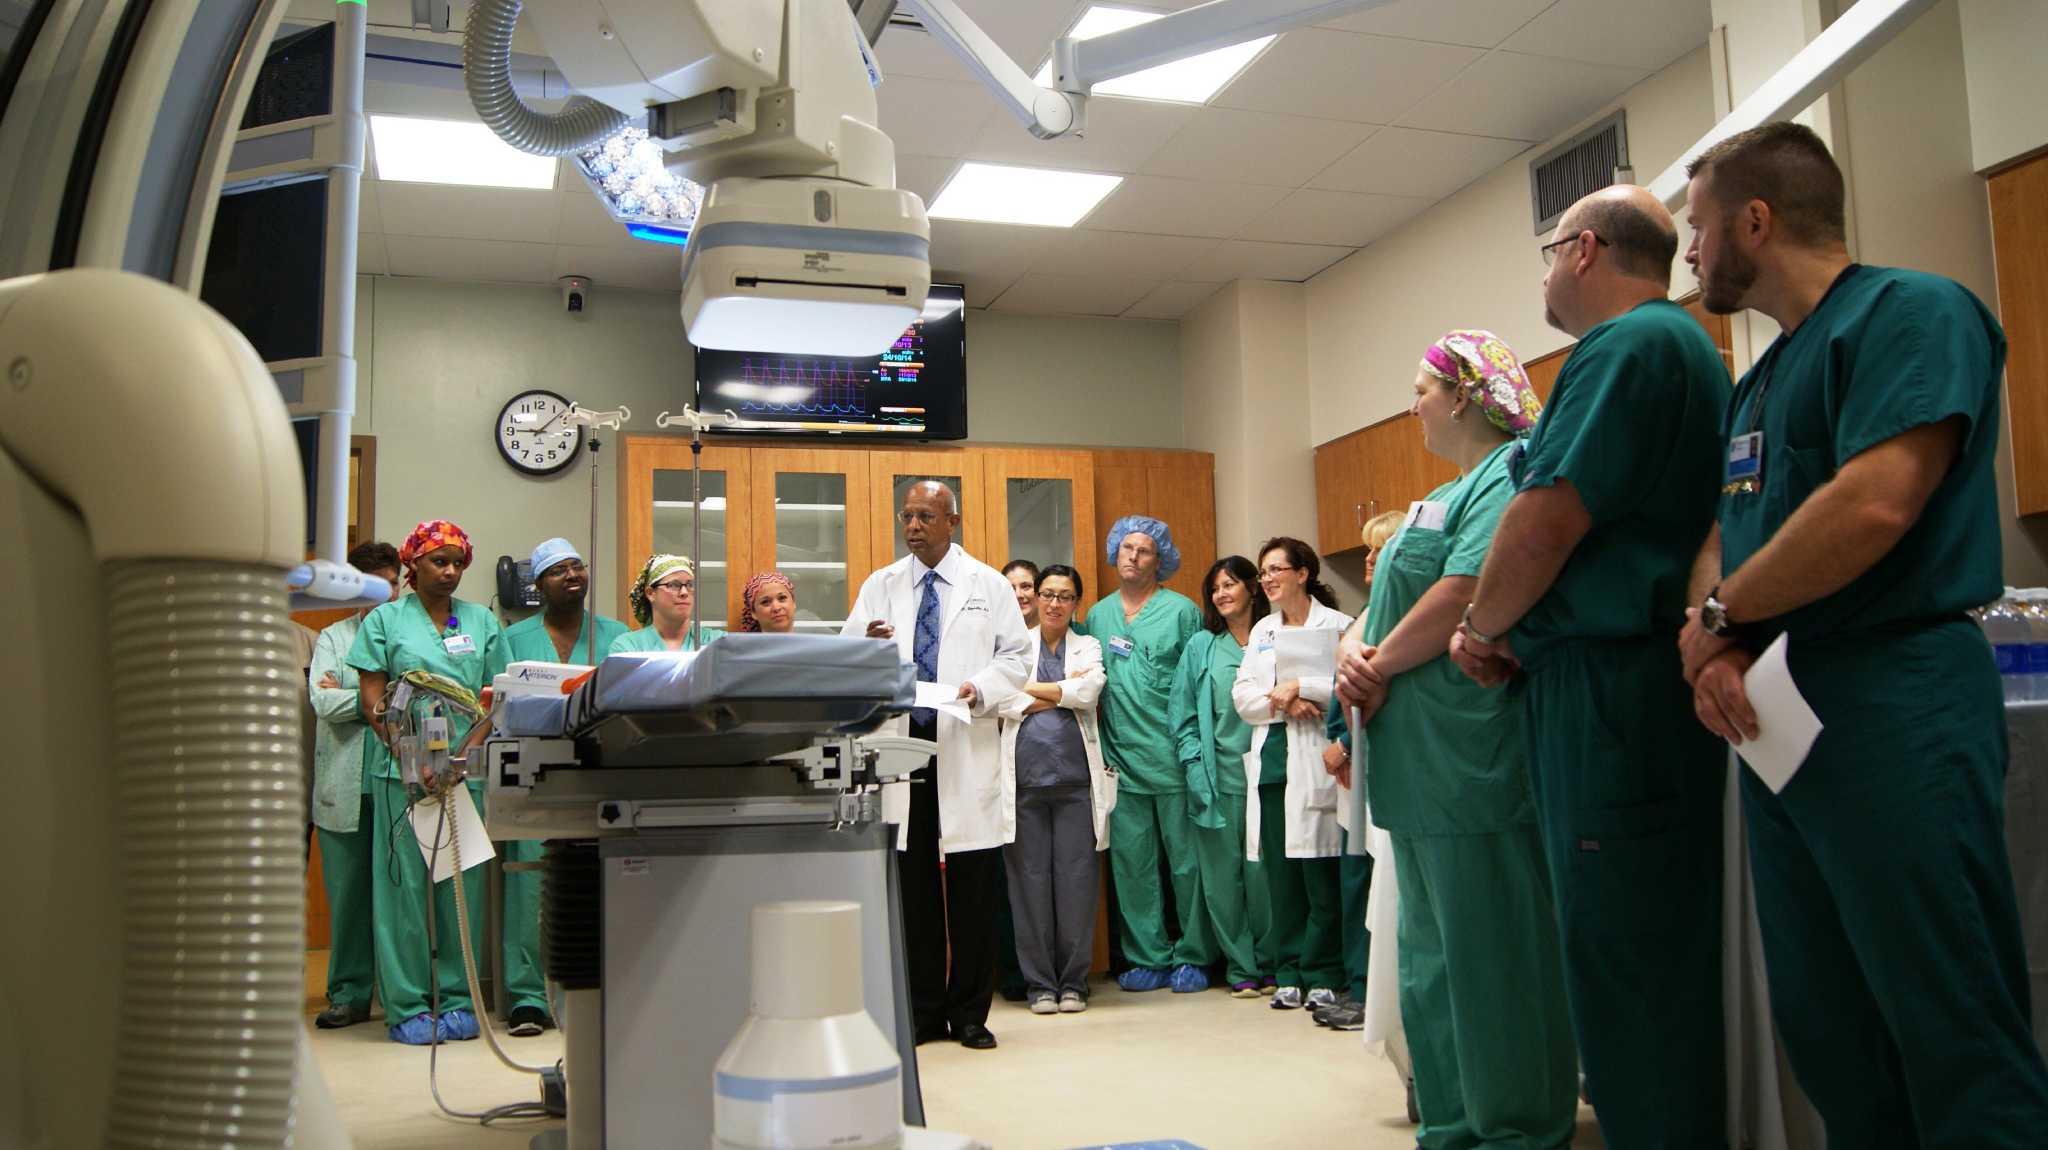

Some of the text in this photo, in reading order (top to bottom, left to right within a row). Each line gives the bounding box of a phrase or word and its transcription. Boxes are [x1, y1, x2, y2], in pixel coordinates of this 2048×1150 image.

[882, 353, 912, 361] 24/10/14
[521, 404, 530, 413] 11
[534, 400, 545, 410] 12
[552, 404, 556, 413] 1
[506, 426, 515, 436] 9
[511, 440, 520, 450] 8
[558, 441, 567, 450] 4
[521, 450, 529, 459] 7
[535, 453, 544, 463] 6
[548, 450, 556, 460] 5
